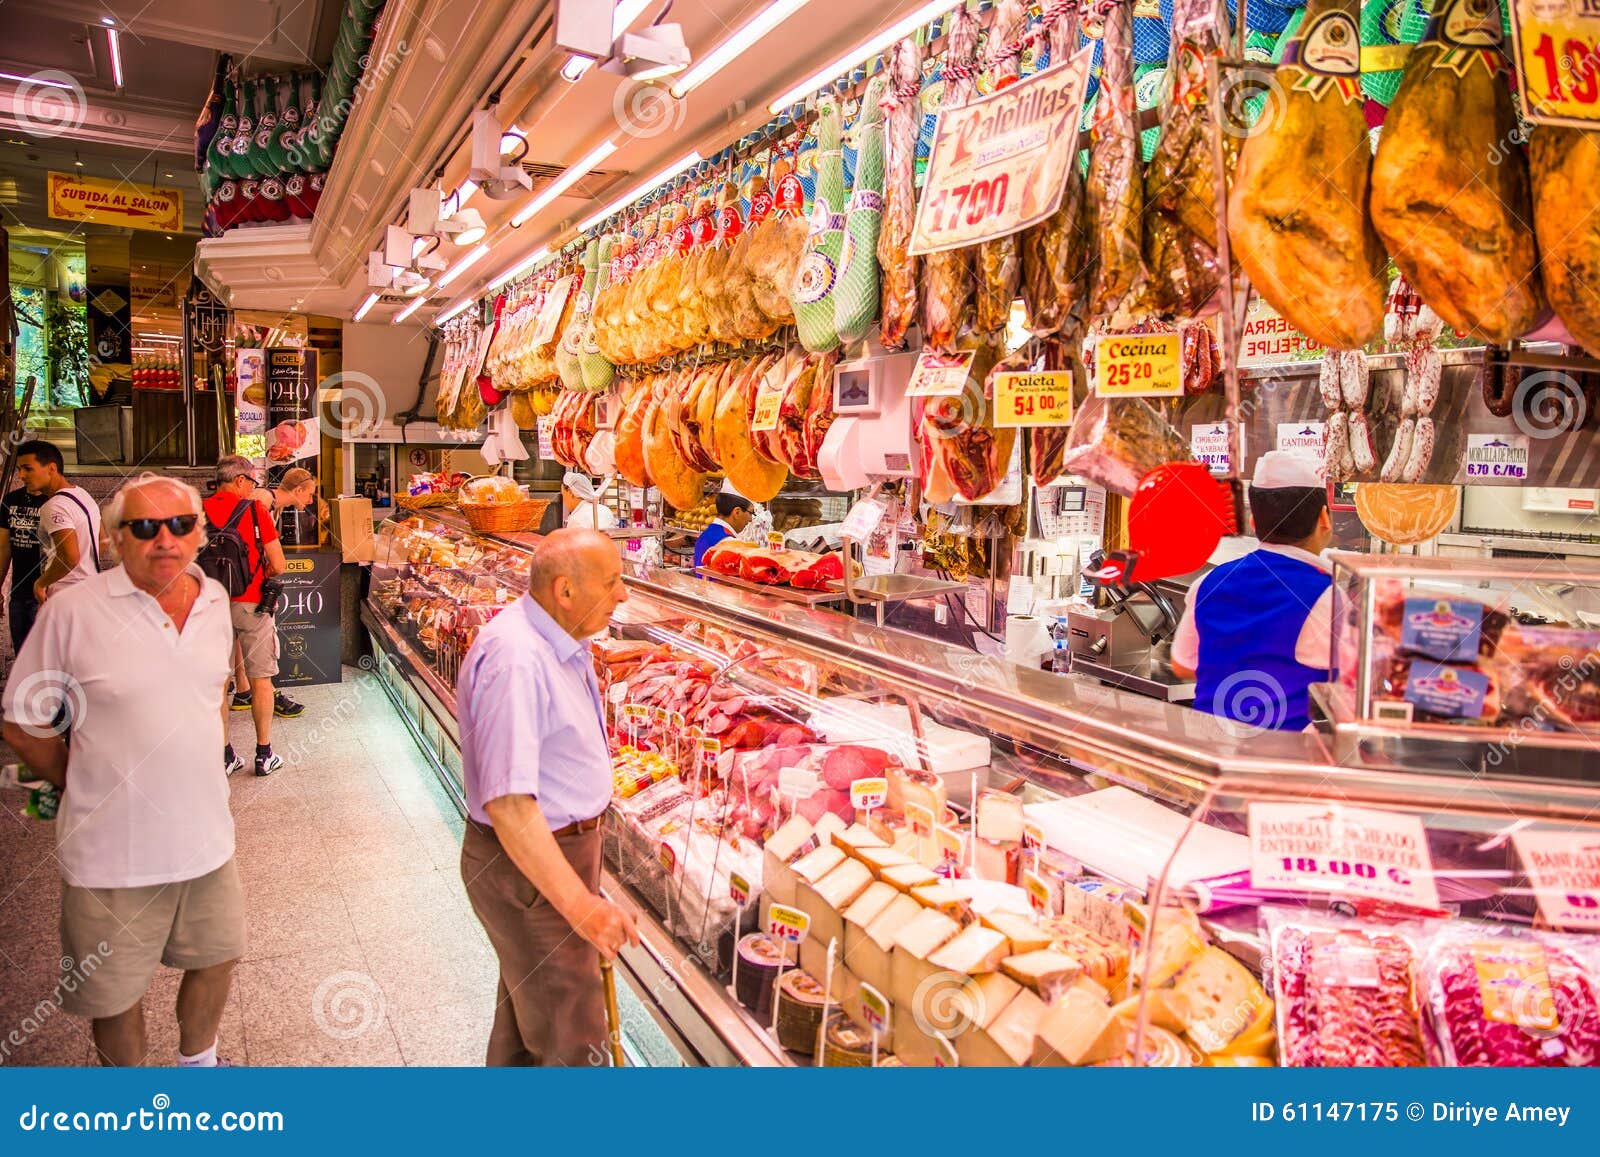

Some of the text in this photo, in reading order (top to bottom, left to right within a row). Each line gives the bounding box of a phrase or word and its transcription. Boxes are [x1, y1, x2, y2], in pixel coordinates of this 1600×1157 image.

[950, 82, 1076, 166] Paletillas
[61, 188, 169, 211] SUBIDA AL SALON
[1109, 341, 1168, 359] Cecina
[1008, 376, 1055, 390] Paleta
[1507, 448, 1527, 463] PATATA
[285, 562, 308, 570] OEL
[1280, 857, 1377, 879] 18.00
